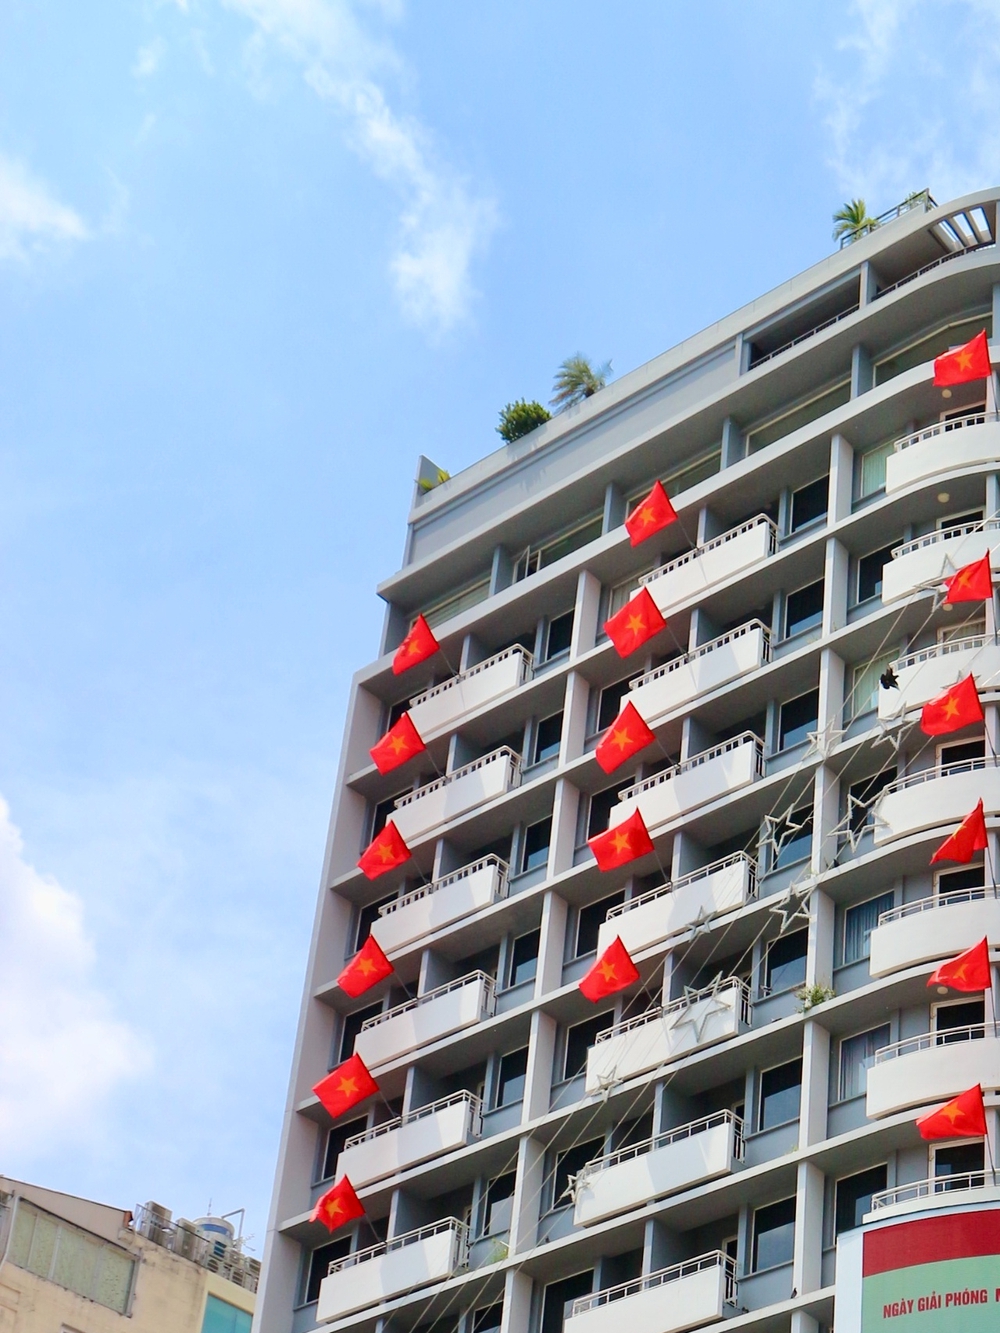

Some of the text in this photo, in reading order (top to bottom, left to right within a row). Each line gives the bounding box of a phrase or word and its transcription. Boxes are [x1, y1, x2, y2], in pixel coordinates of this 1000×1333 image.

[883, 1295, 914, 1318] NGÀY
[917, 1291, 941, 1312] GIẢI
[945, 1288, 988, 1307] PHÓNG
